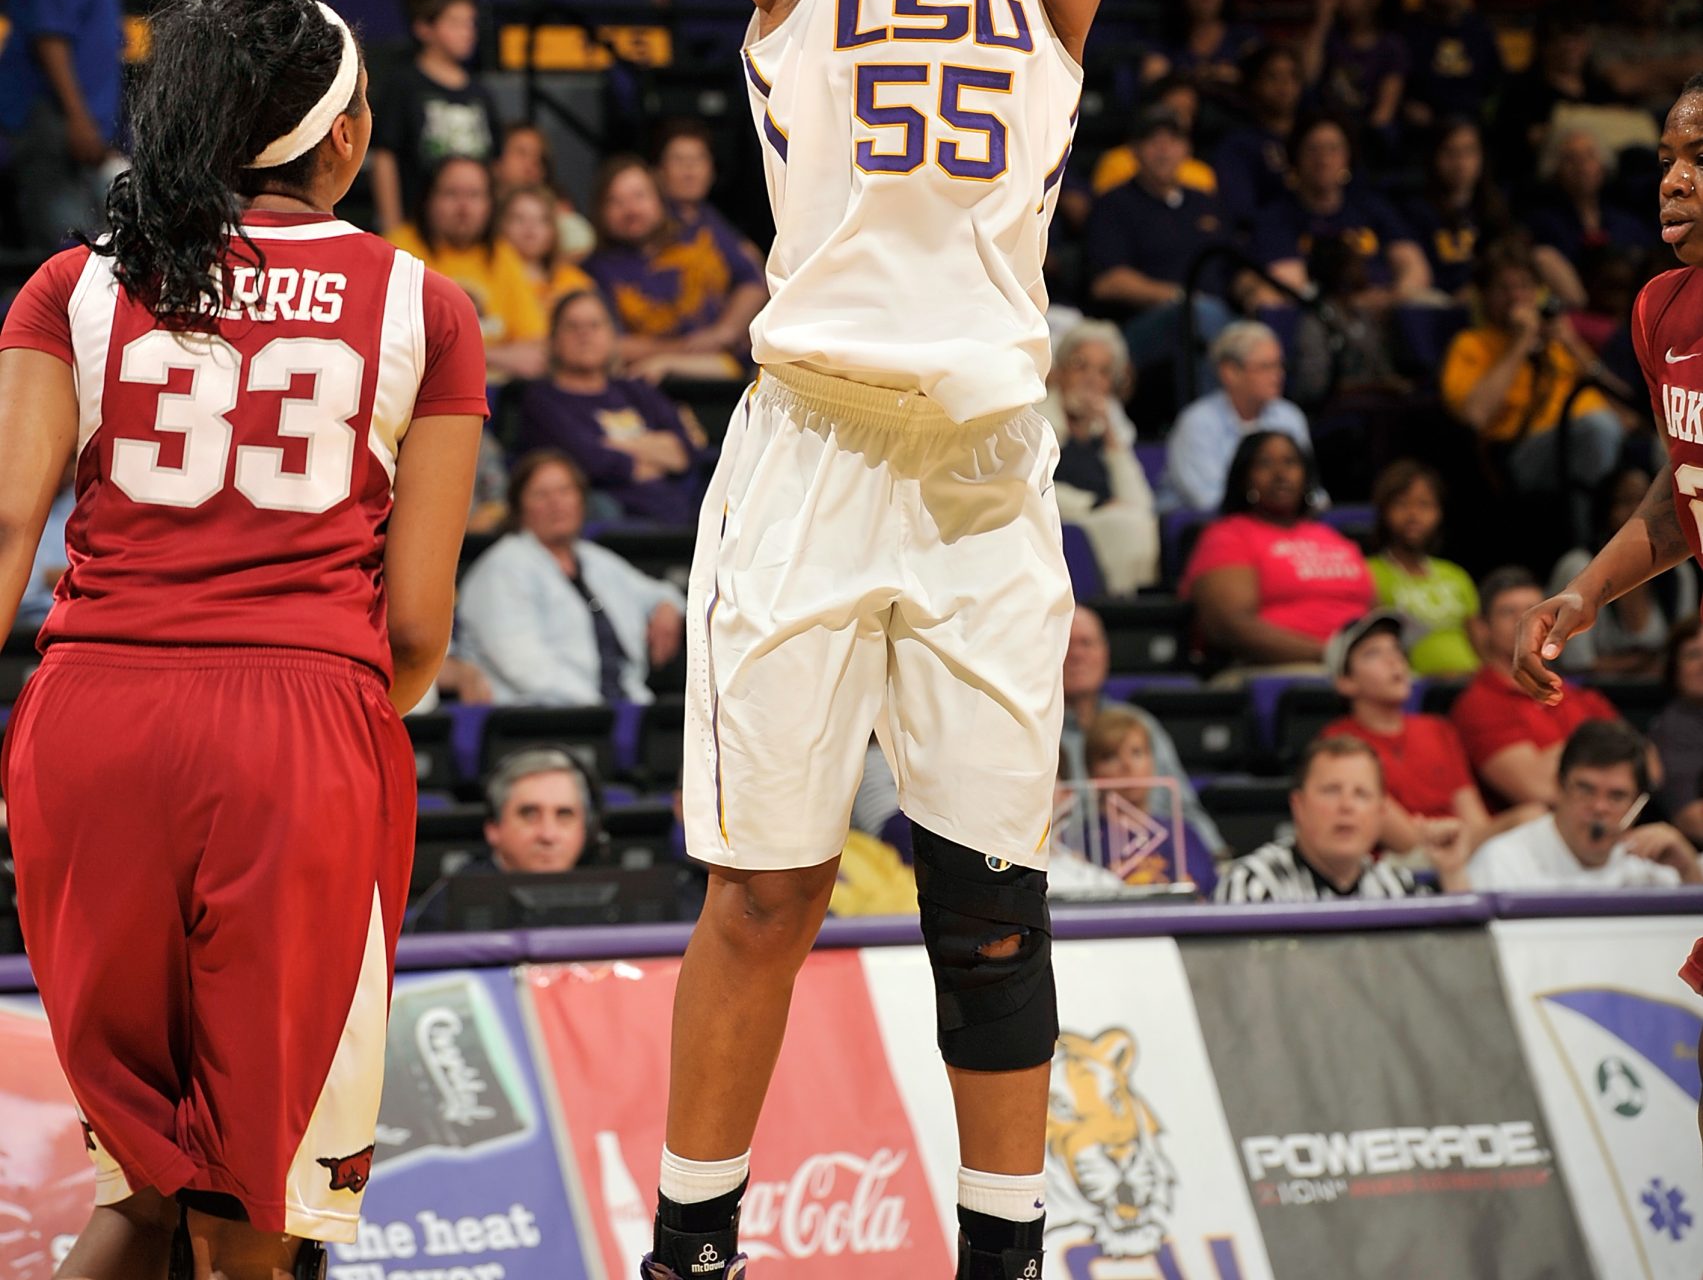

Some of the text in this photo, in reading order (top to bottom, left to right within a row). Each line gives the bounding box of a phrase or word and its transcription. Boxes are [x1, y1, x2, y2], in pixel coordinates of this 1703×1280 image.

[853, 62, 1015, 182] 55
[110, 329, 365, 514] 33
[1241, 1120, 1545, 1182] POWERADE
[415, 1202, 541, 1257] heat
